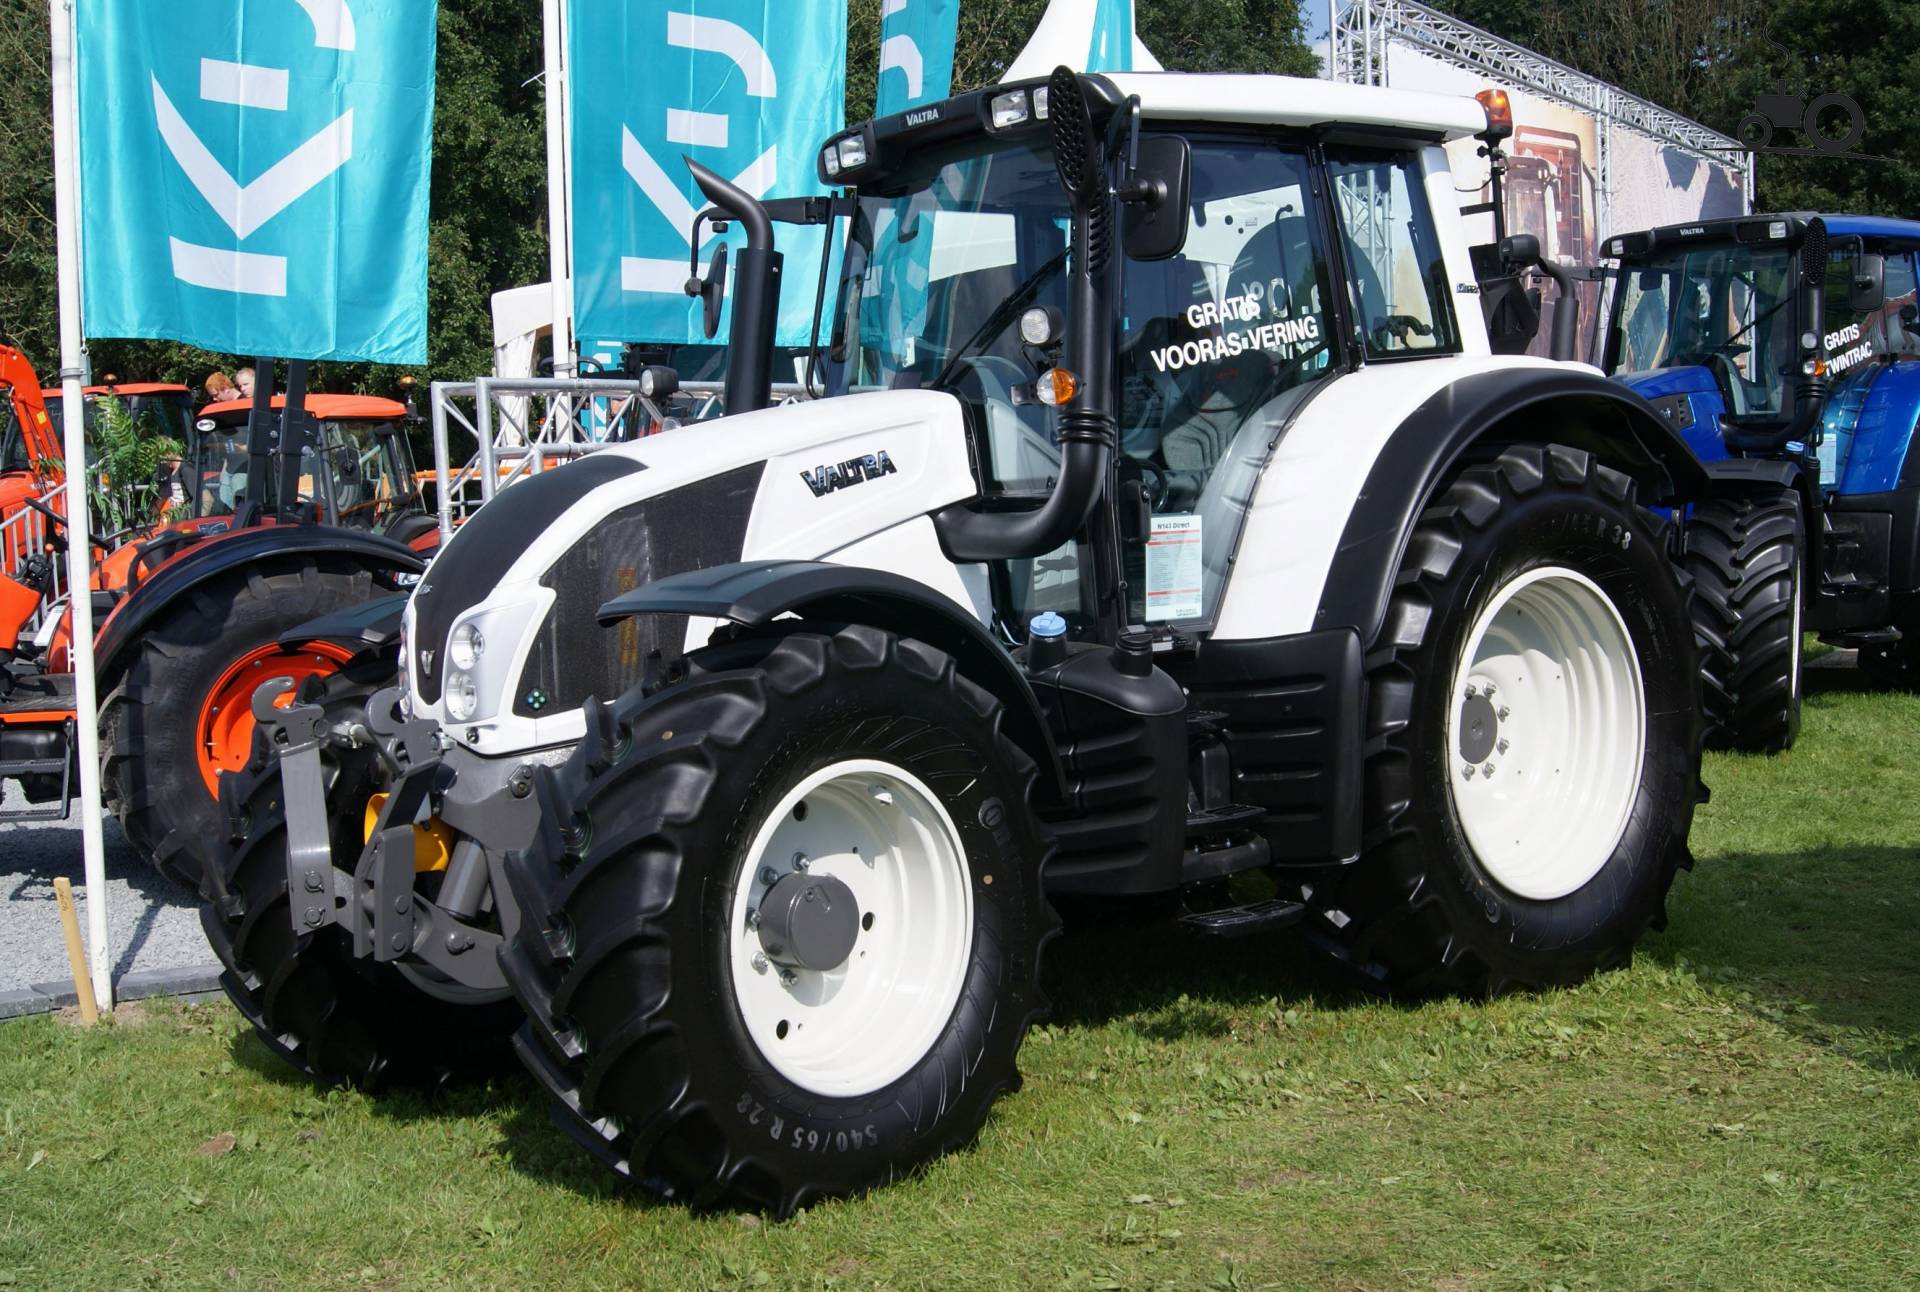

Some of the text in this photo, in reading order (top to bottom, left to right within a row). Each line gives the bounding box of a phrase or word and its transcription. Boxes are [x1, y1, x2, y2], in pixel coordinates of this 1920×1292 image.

[905, 108, 939, 127] VALTRA
[1187, 293, 1261, 329] GRATIS
[1823, 323, 1860, 351] GRATIS
[1824, 341, 1873, 377] TWINTRAC
[800, 449, 898, 498] VALTRA
[770, 1114, 785, 1139] R
[791, 1123, 878, 1153] 540/65
